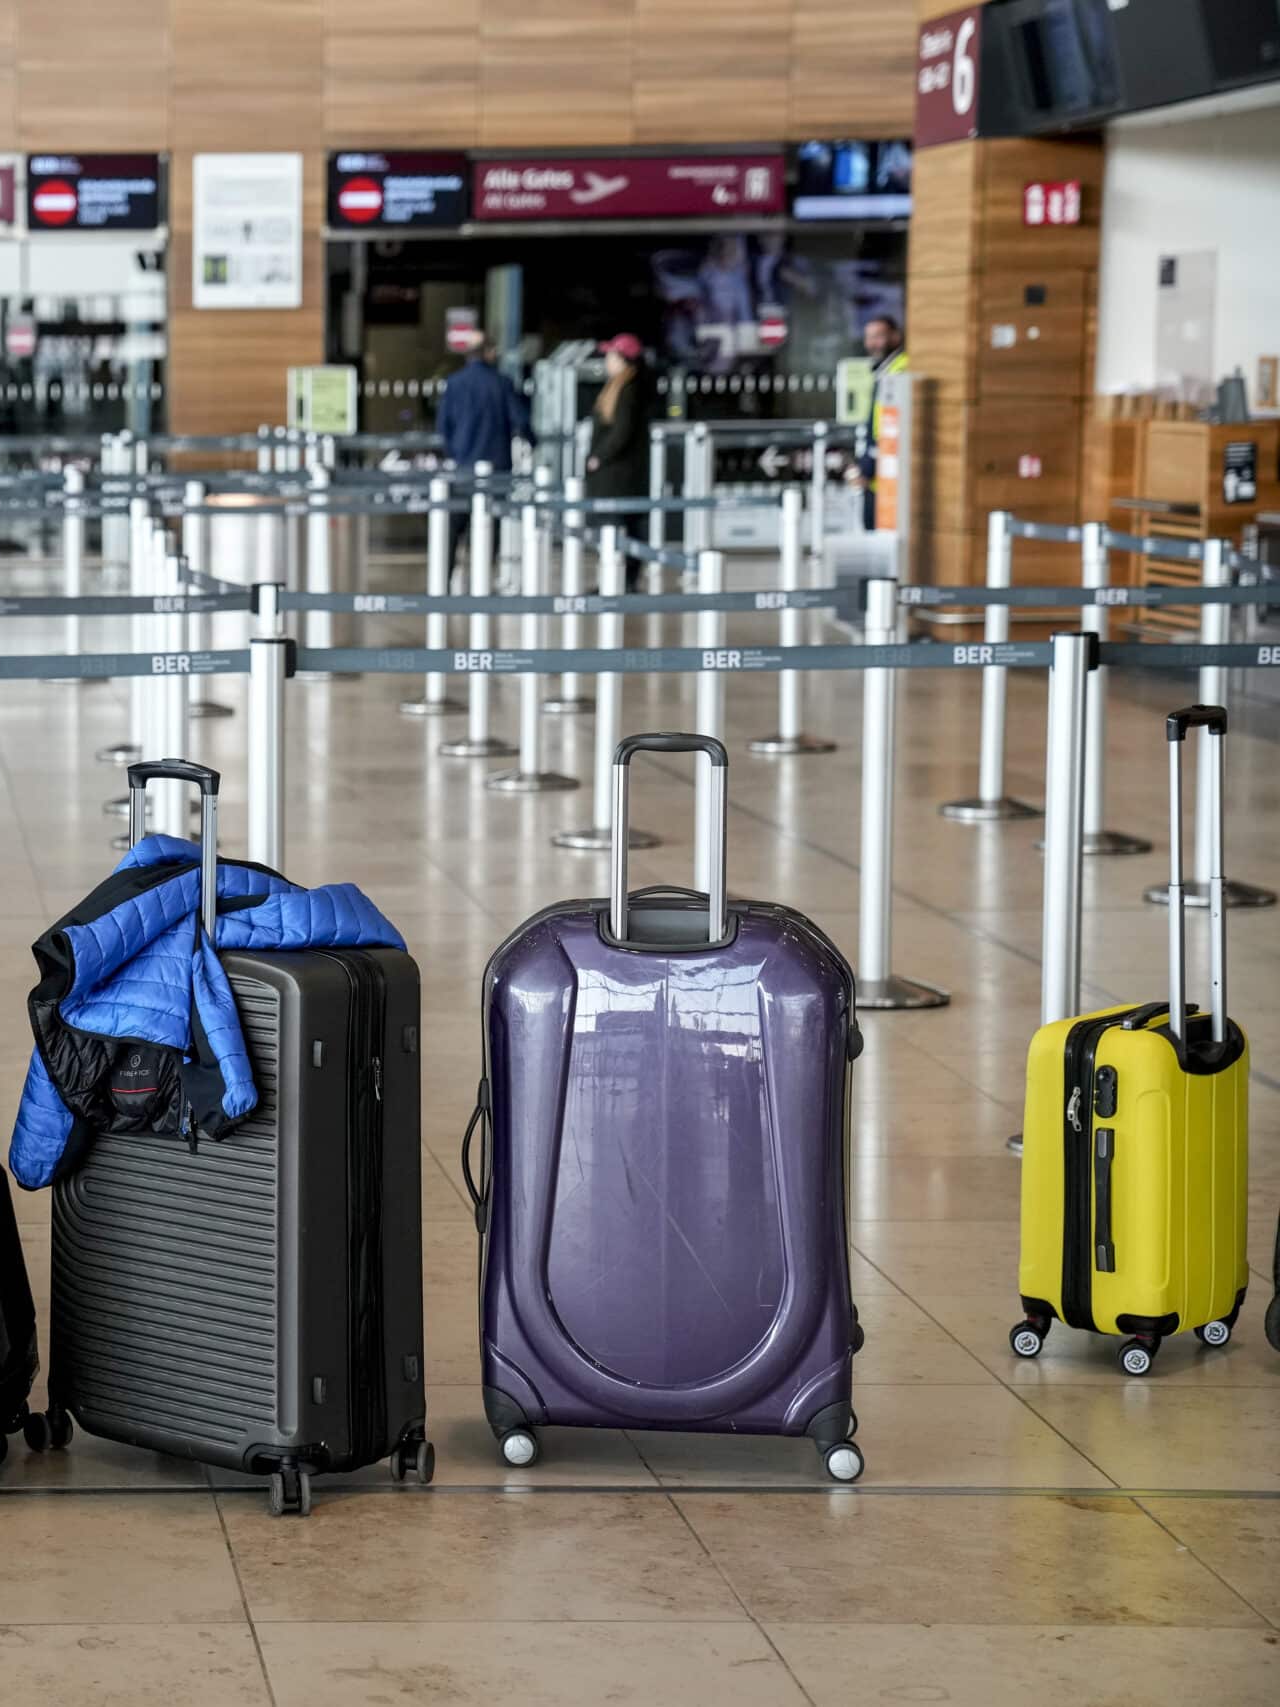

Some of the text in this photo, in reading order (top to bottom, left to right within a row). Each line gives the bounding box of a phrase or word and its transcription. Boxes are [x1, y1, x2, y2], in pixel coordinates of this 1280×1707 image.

[952, 16, 975, 115] 6
[484, 168, 574, 190] Alle Gates
[354, 595, 386, 611] BER
[756, 593, 787, 608] BER
[900, 587, 922, 603] ER
[1094, 588, 1128, 604] BER
[153, 597, 185, 612] BER
[554, 597, 586, 612] BER
[455, 652, 493, 670] BER
[703, 650, 741, 668] BER
[953, 646, 992, 664] BER
[1258, 646, 1280, 664] BE
[152, 656, 190, 674] BER
